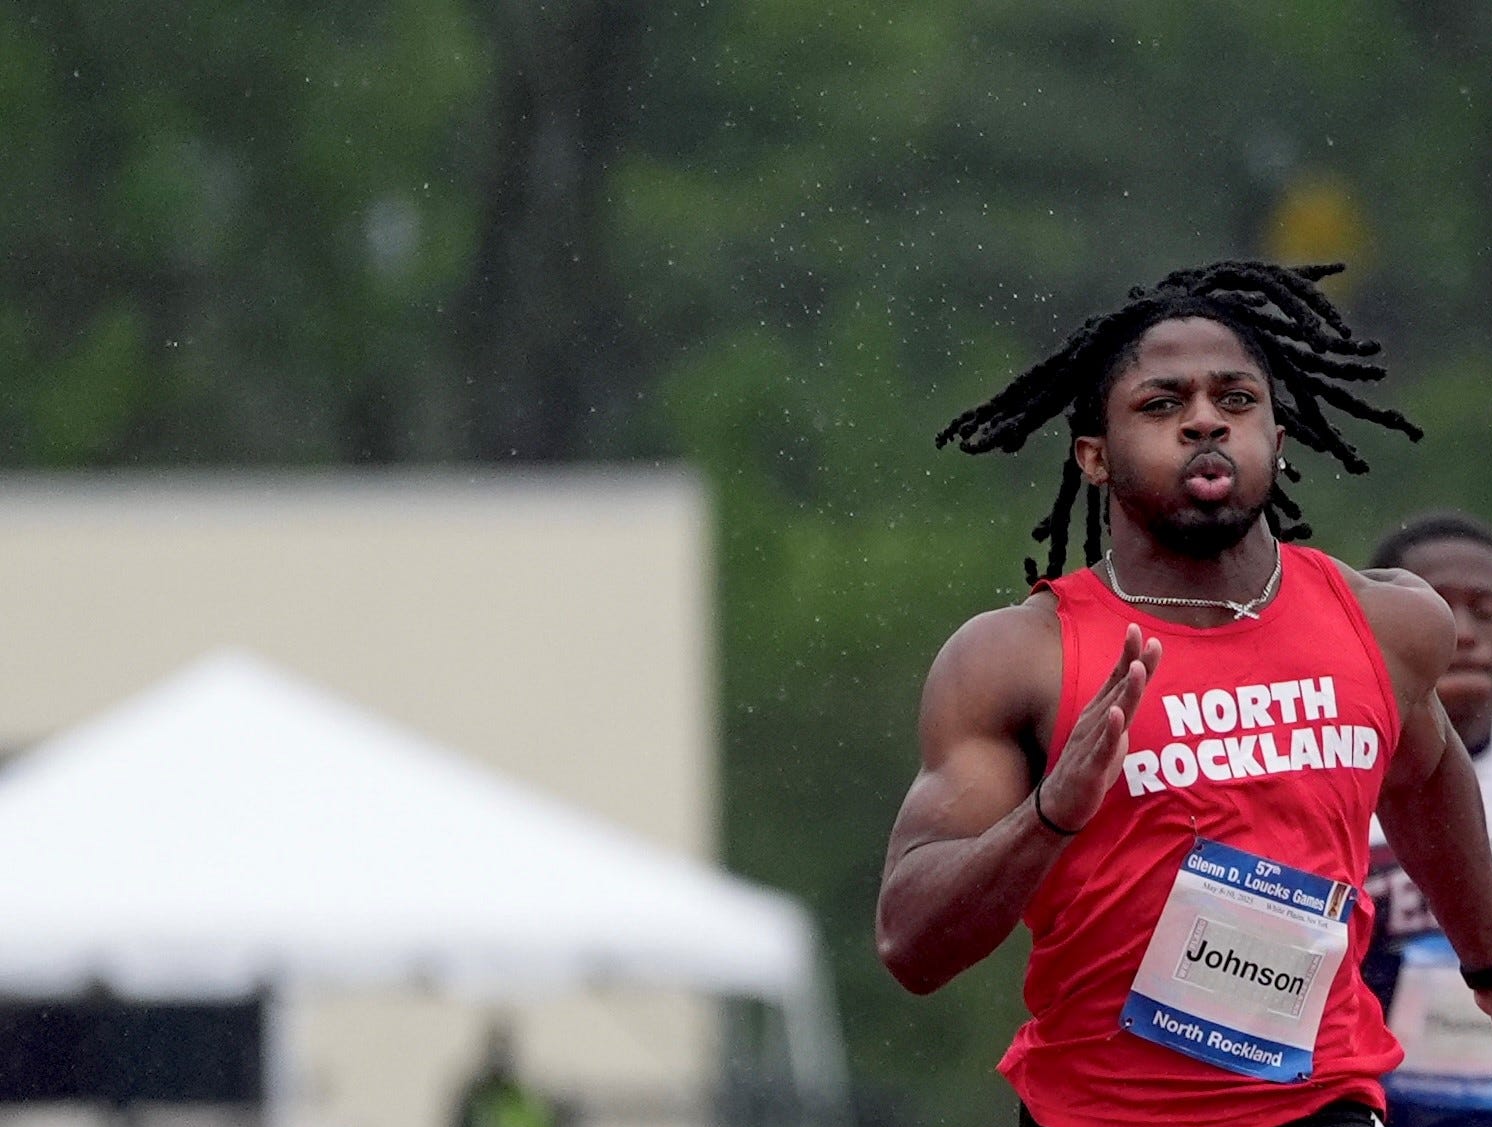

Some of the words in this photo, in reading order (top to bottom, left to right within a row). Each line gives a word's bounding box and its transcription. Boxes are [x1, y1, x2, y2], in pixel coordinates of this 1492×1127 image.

[1161, 676, 1338, 737] NORTH
[1122, 725, 1379, 797] ROCKLAND
[1187, 854, 1225, 878] Glenn
[1227, 867, 1241, 884] D.
[1244, 873, 1291, 900] Loucks
[1292, 889, 1325, 911] Games
[1255, 860, 1281, 877] 57th
[1186, 940, 1304, 996] Johnson
[1152, 1009, 1204, 1043] North
[1207, 1030, 1284, 1068] Rockland
